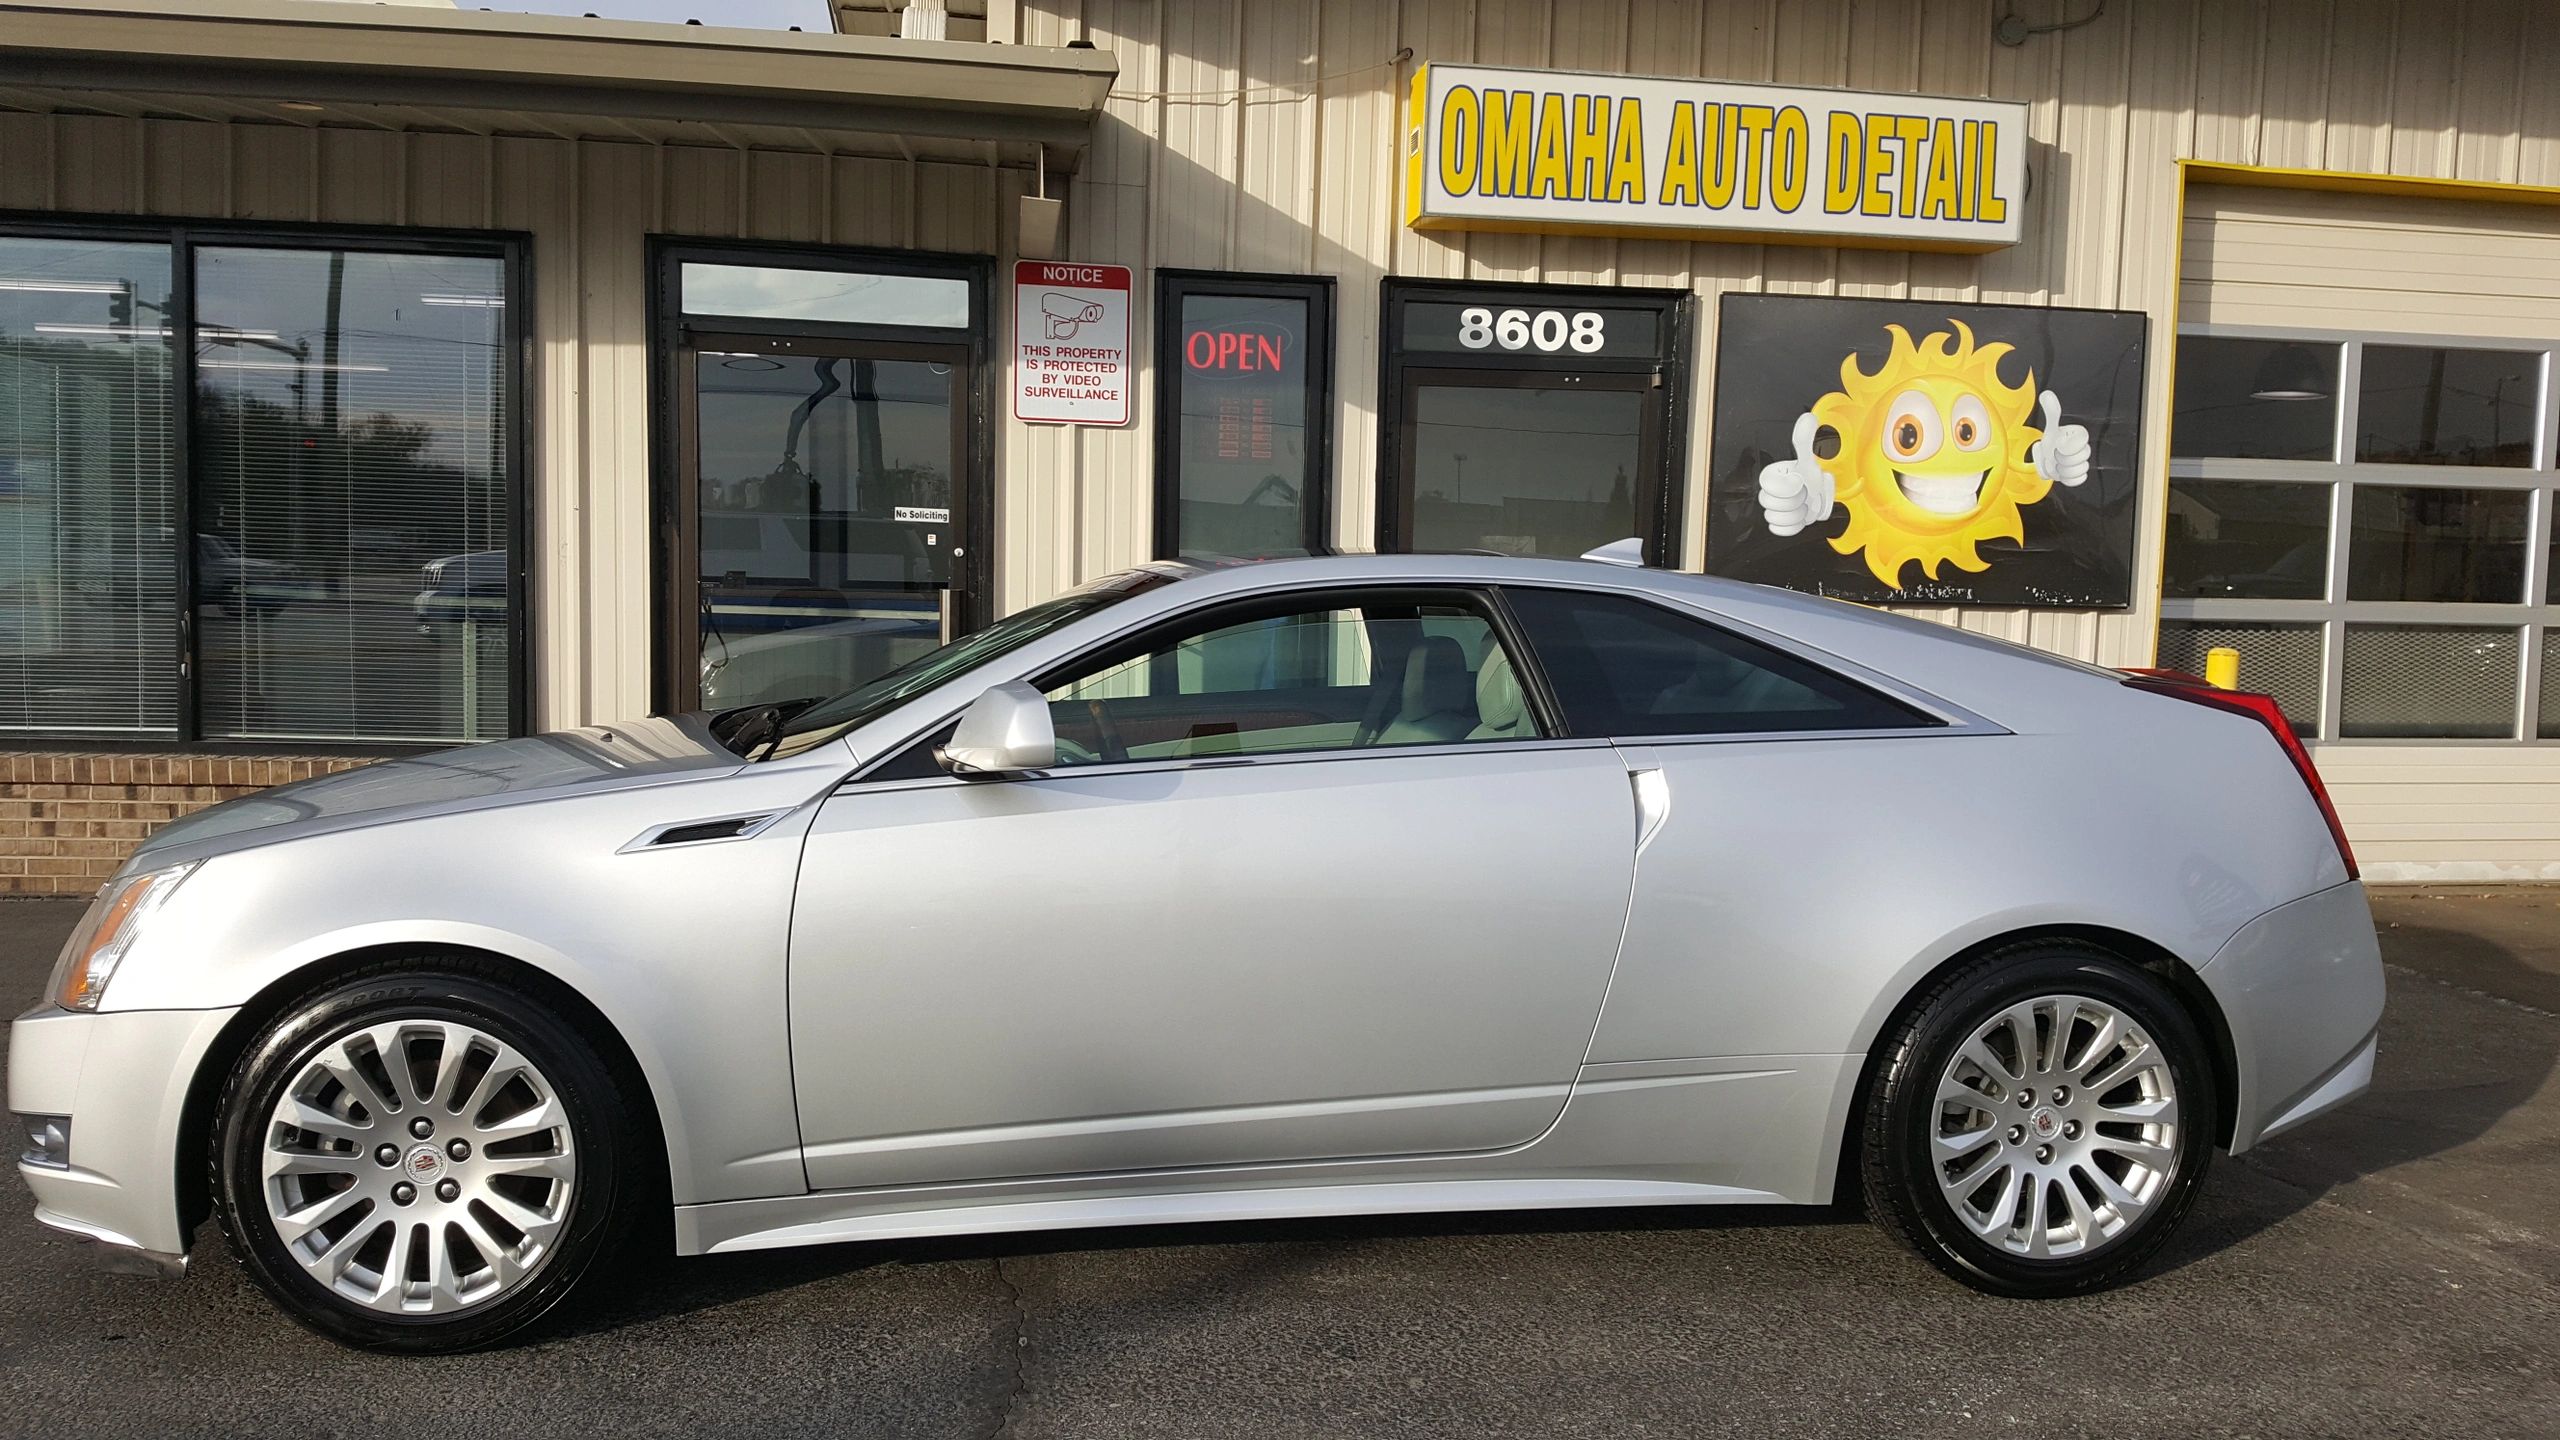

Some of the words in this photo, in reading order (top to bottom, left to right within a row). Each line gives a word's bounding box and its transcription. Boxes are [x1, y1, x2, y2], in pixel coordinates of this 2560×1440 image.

[1438, 84, 1646, 204] OMAHA
[1659, 100, 1809, 212] AUTO
[1823, 110, 2007, 224] DETAIL
[1043, 266, 1103, 283] NOTICE
[1458, 307, 1605, 353] 8608
[1022, 345, 1051, 357] THIS
[1056, 347, 1122, 360] PROPERTY
[1186, 331, 1282, 371] OPEN
[1026, 359, 1038, 370] IS
[1044, 361, 1117, 374] PROTECTED
[1042, 374, 1058, 385] BY
[1063, 375, 1101, 387] VIDEO
[1024, 386, 1119, 401] SURVEILLANCE
[896, 509, 906, 518] No
[910, 511, 948, 521] Soliciting
